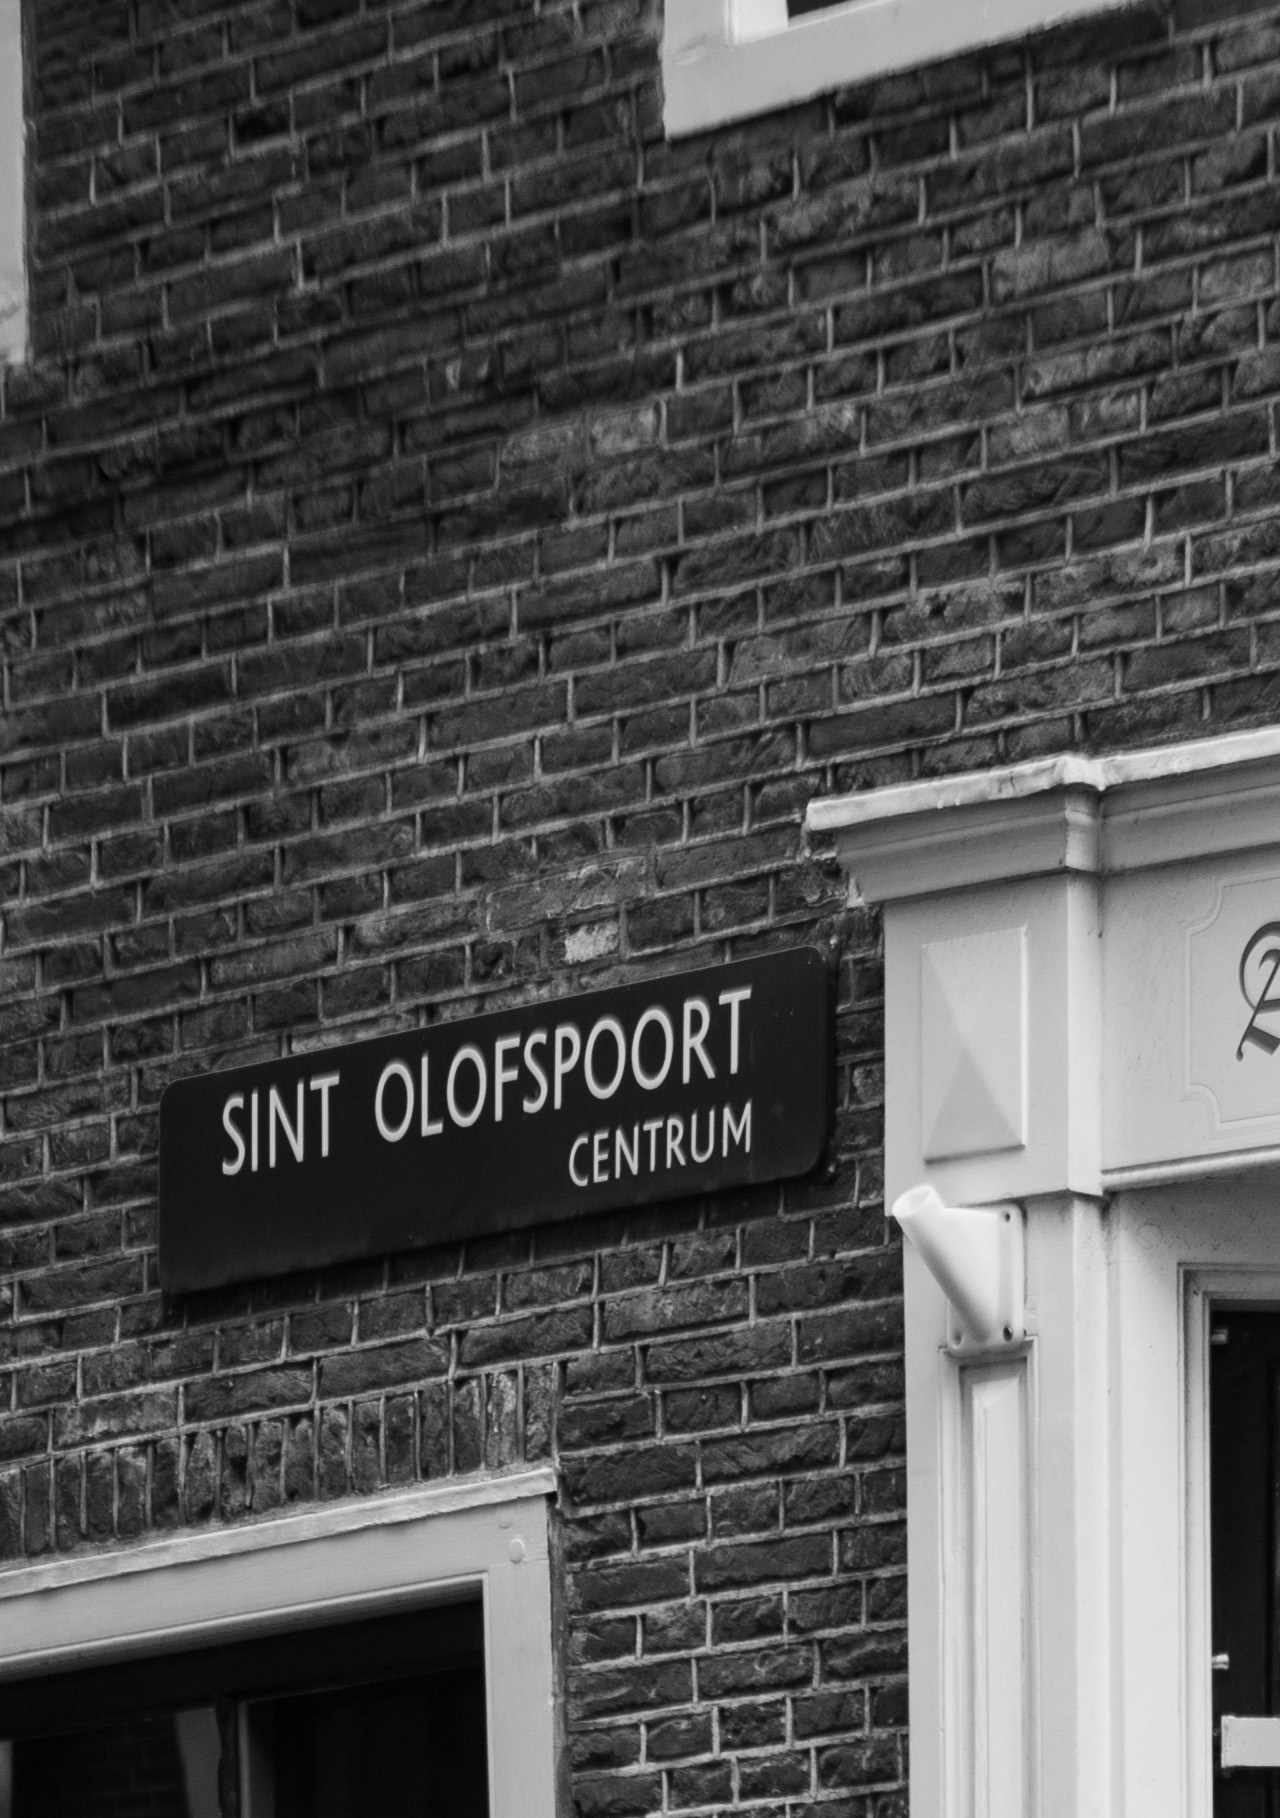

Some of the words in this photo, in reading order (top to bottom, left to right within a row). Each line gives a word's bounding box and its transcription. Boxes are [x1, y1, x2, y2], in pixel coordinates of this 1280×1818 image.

[221, 1070, 341, 1176] SINT
[374, 987, 753, 1143] OLOFSPOORT
[568, 1100, 752, 1187] CENTRUM
